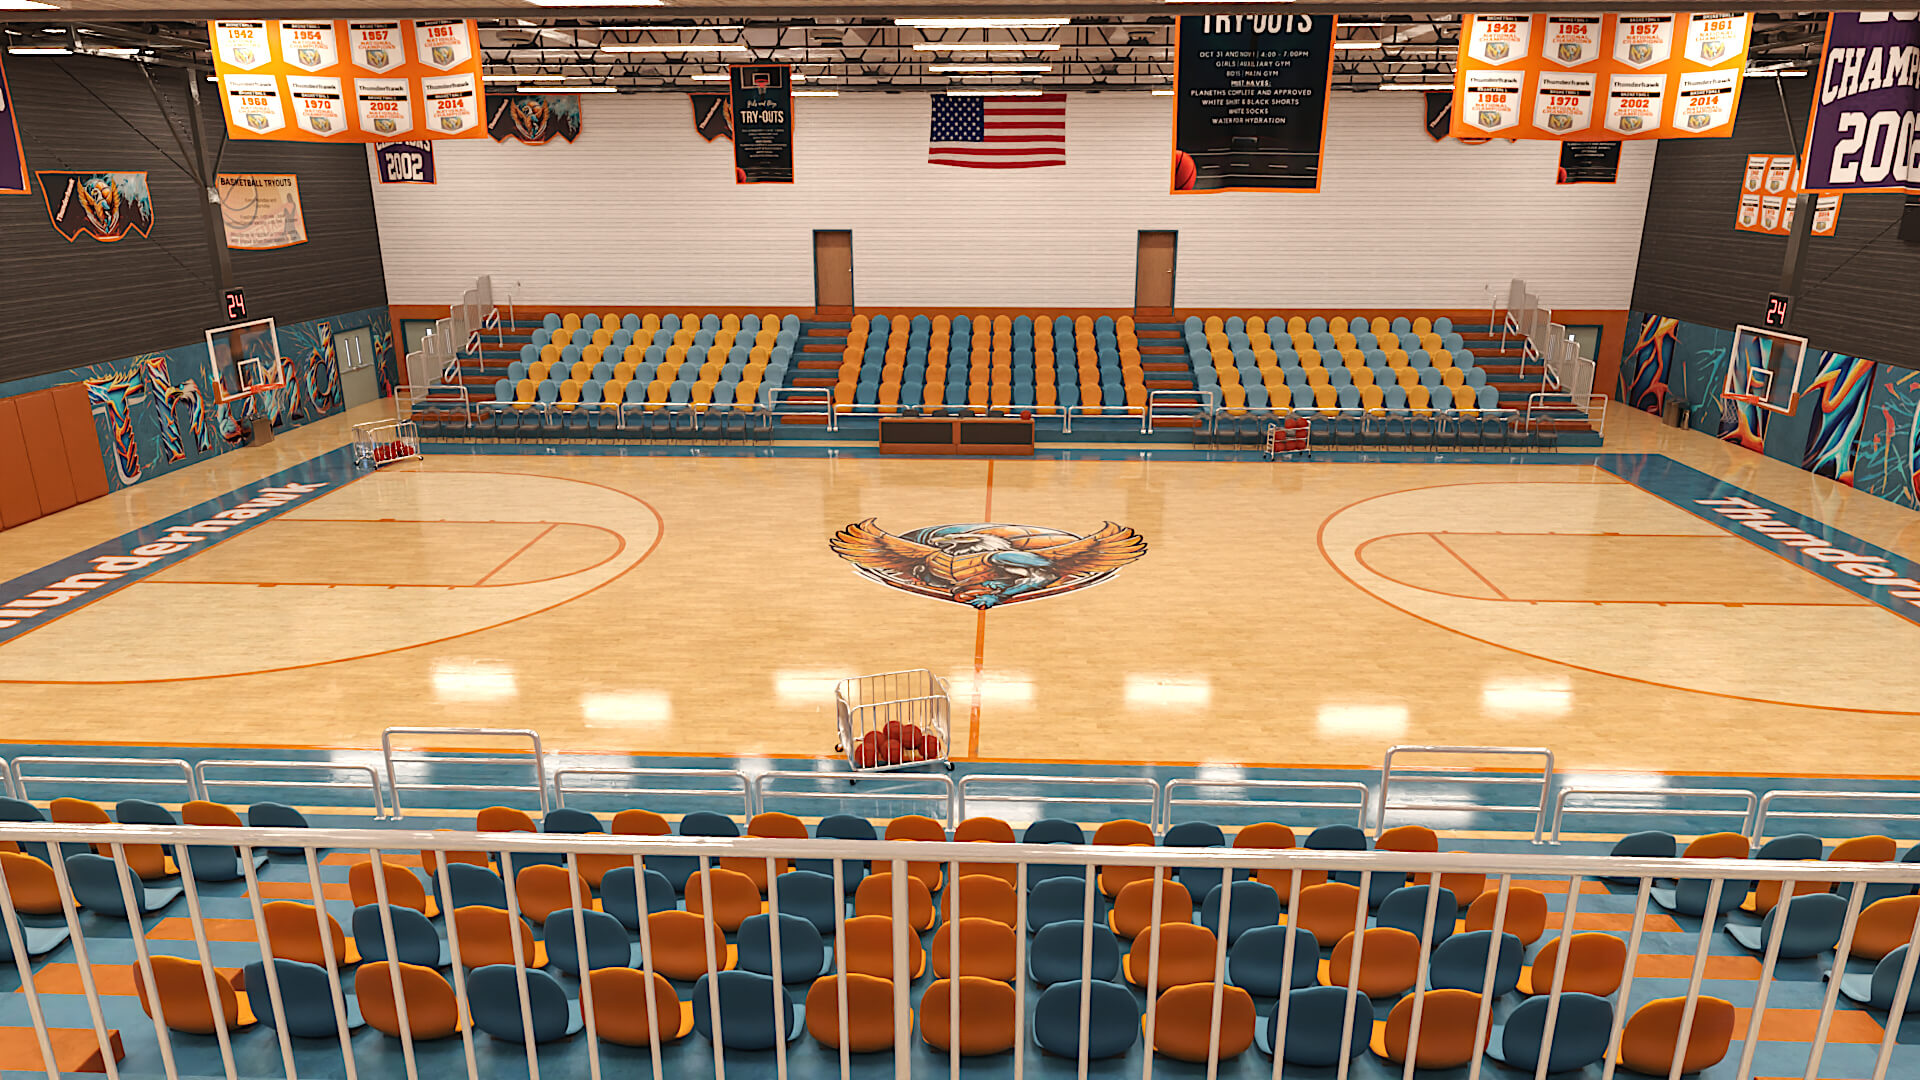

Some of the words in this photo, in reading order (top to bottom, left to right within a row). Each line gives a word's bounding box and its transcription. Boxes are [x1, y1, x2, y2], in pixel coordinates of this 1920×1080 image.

[1487, 23, 1517, 33] 1942
[1559, 25, 1587, 35] 1954
[1630, 24, 1659, 35] 1957
[1704, 20, 1732, 31] 1961
[228, 30, 254, 39] 1942
[294, 31, 321, 40] 1954
[428, 26, 454, 38] 1961
[1478, 94, 1506, 103] 1968
[1550, 96, 1579, 106] 1970
[1620, 99, 1649, 108] 2002
[1690, 96, 1719, 106] 2014
[305, 100, 331, 109] 1970
[370, 102, 398, 111] 2002
[437, 99, 464, 109] 2014
[740, 110, 784, 124] TRY-OUTS
[385, 153, 424, 180] 2002
[220, 177, 263, 187] BASKETBALL
[264, 178, 292, 187] TRYOUTS
[226, 294, 245, 318] 24
[1767, 299, 1786, 325] 24
